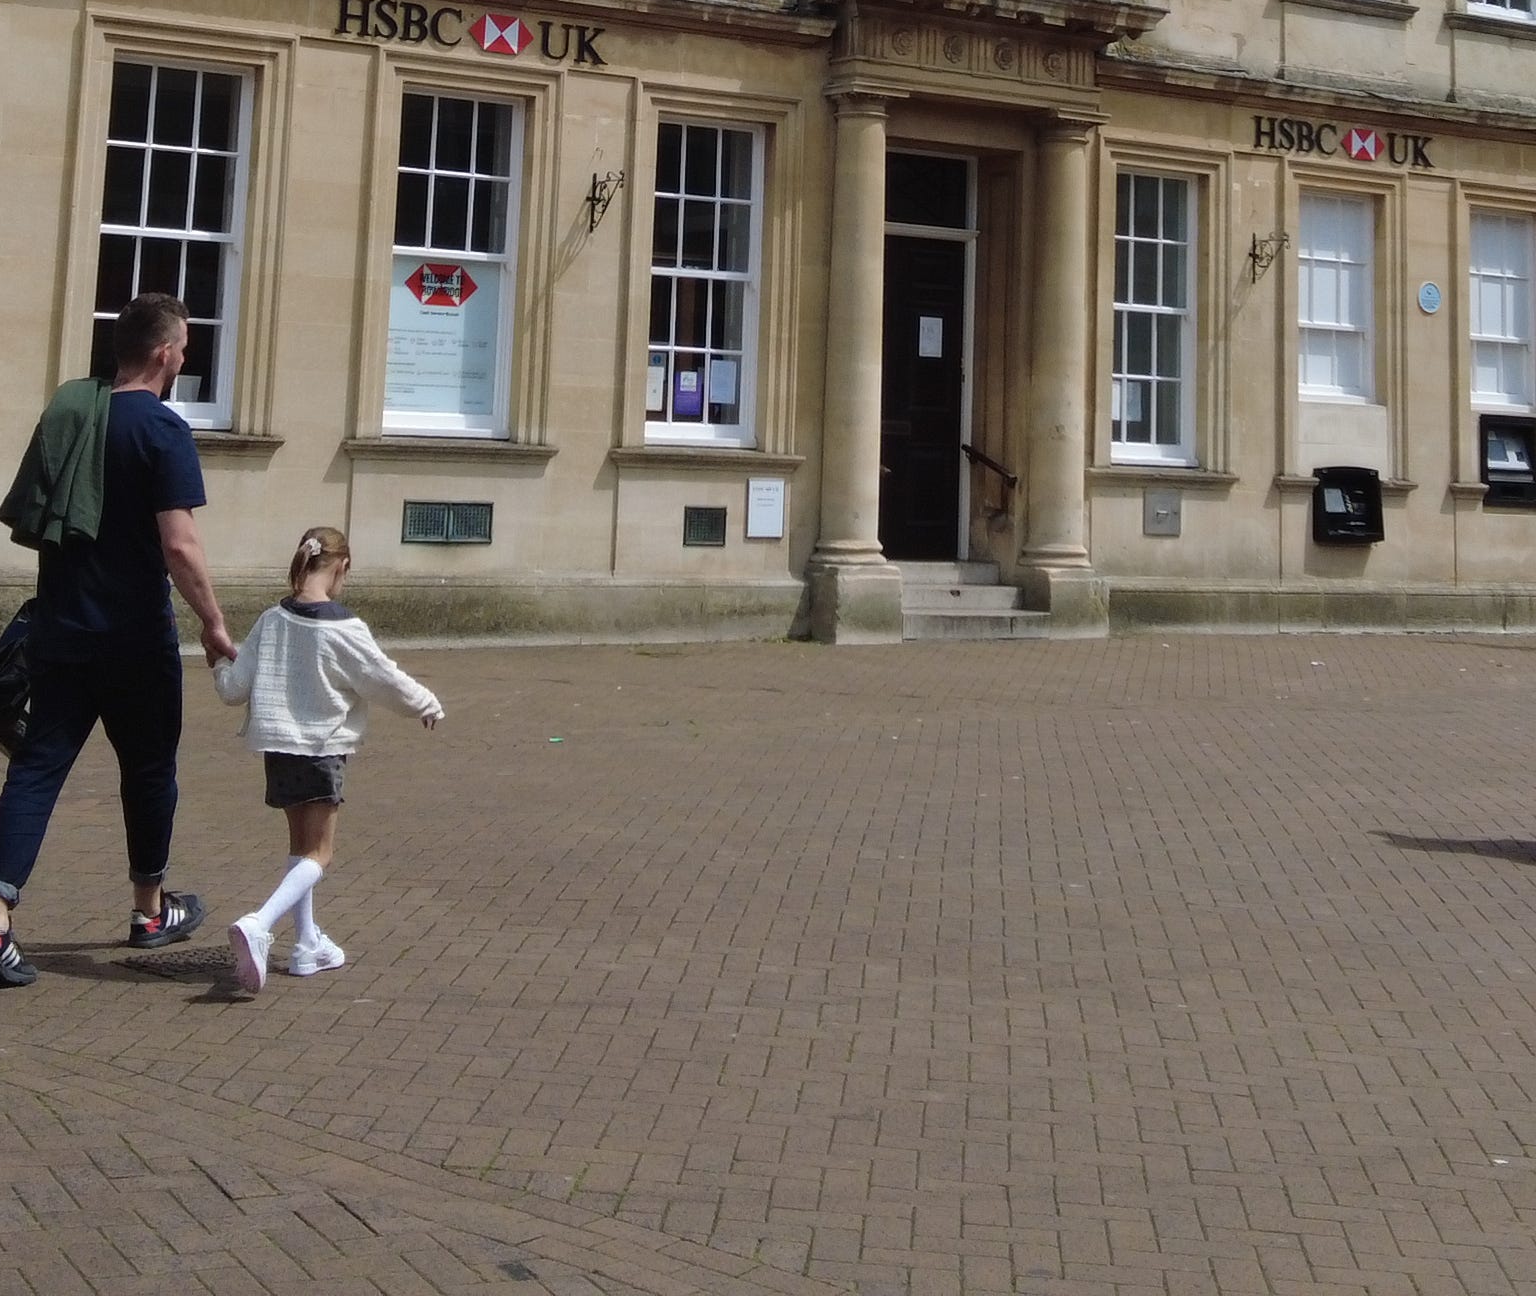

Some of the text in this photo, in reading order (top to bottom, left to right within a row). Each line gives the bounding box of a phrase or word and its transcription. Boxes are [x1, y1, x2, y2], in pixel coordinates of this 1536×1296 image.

[537, 20, 608, 65] UK
[1250, 115, 1435, 168] HSBC UK
